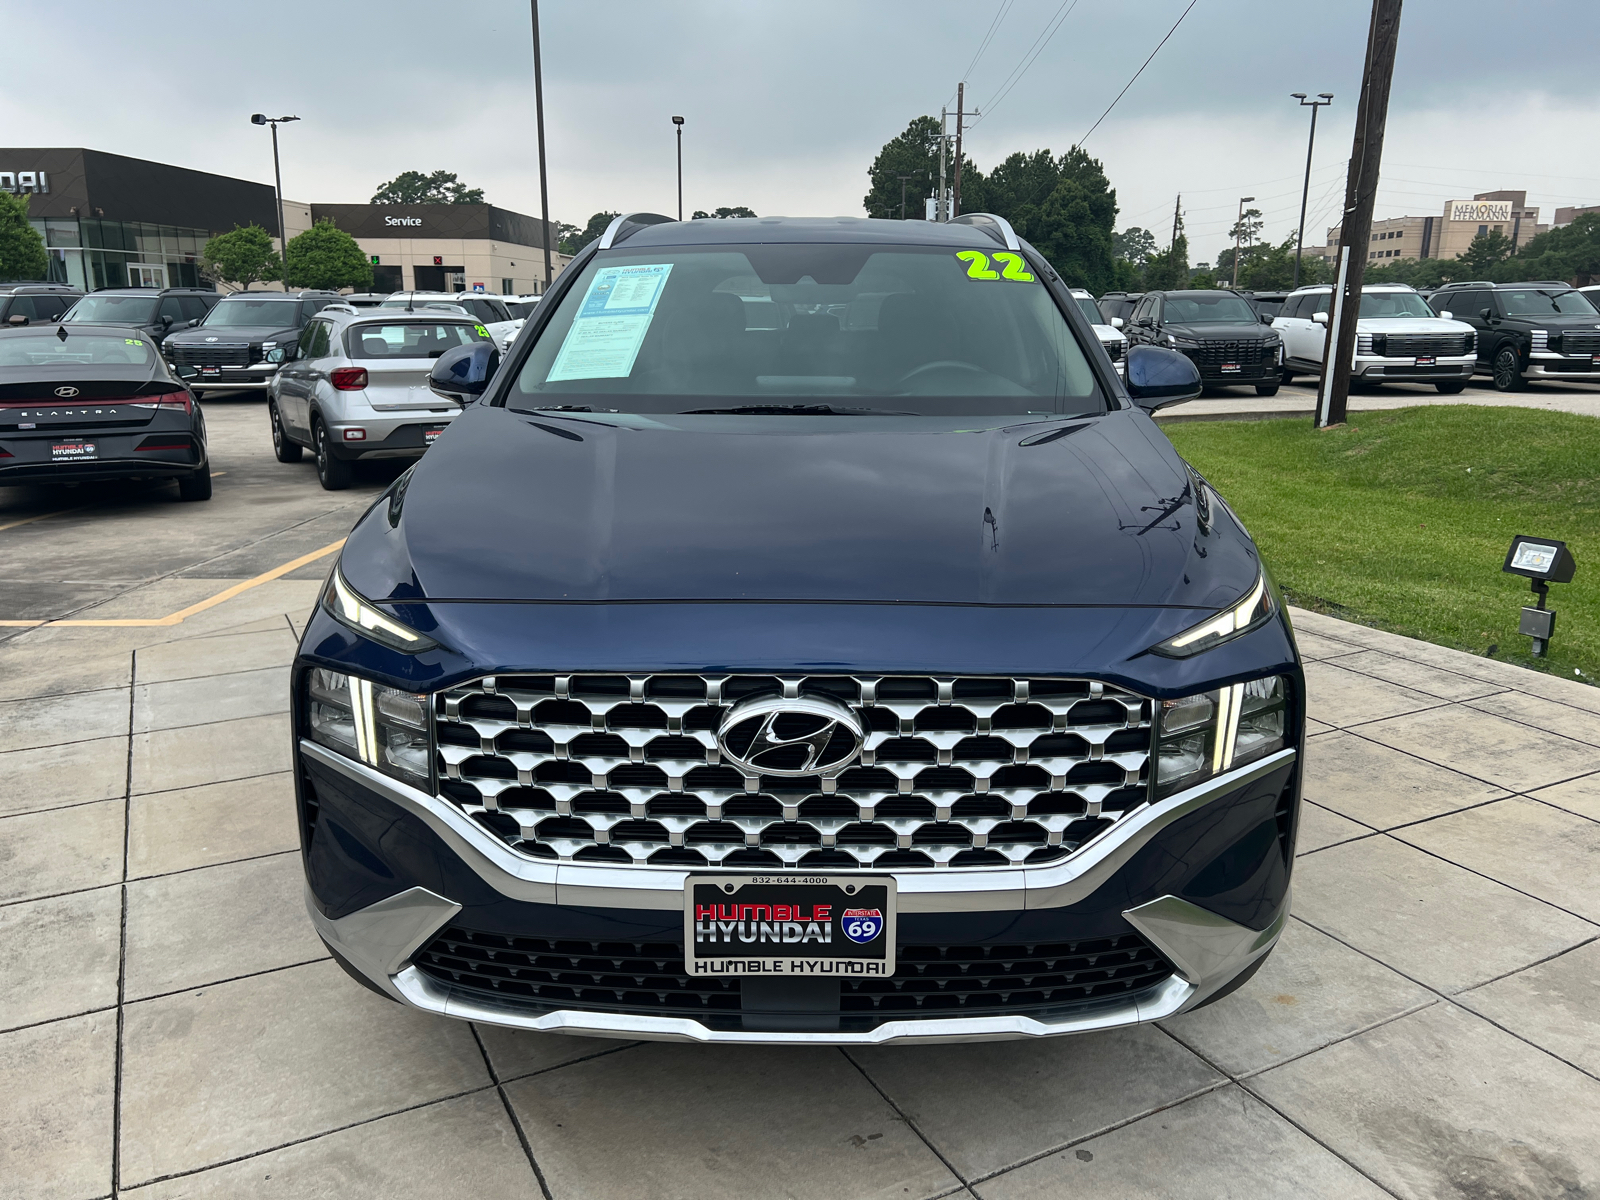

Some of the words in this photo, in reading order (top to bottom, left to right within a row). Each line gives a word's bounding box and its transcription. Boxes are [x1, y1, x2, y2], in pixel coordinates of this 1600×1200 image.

[1454, 204, 1509, 214] MEMORIAL
[385, 216, 422, 226] Service
[1453, 211, 1508, 221] HERMANN
[956, 250, 1035, 282] 22
[474, 325, 490, 338] 25
[124, 339, 143, 347] 25
[21, 409, 117, 417] ELANTRA
[696, 904, 832, 921] HUMBLE
[696, 922, 832, 943] HYUNDAI
[848, 921, 876, 937] 69
[695, 960, 783, 973] HUMBLE
[790, 961, 886, 975] HYUNDAI
